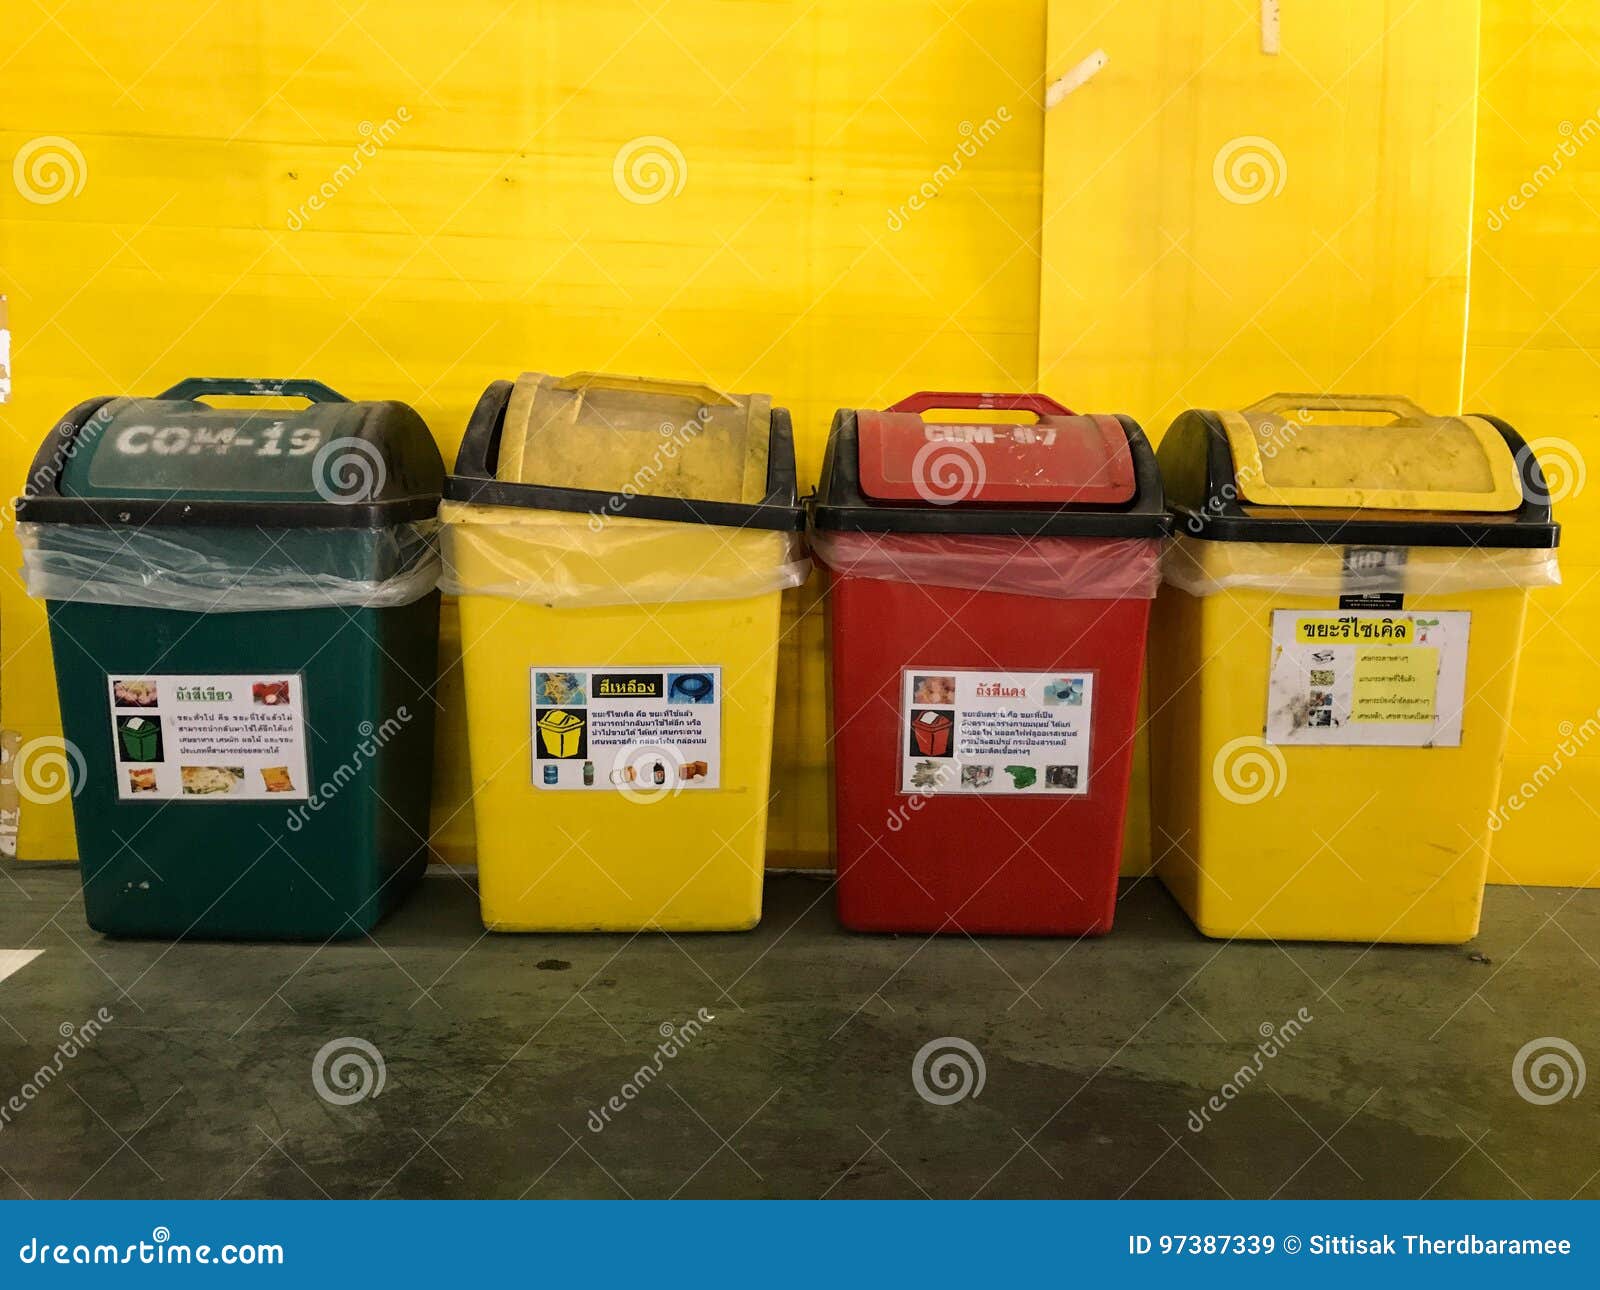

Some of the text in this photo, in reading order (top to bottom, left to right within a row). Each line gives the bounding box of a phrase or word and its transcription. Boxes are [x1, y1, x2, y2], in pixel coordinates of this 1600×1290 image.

[116, 421, 321, 455] COM-19
[1304, 617, 1406, 638] ขยะรีไซเคิล
[176, 686, 233, 700] ถังสีเขียว
[600, 679, 656, 693] สีเหลือง
[976, 683, 1026, 697] ถังสีแดง
